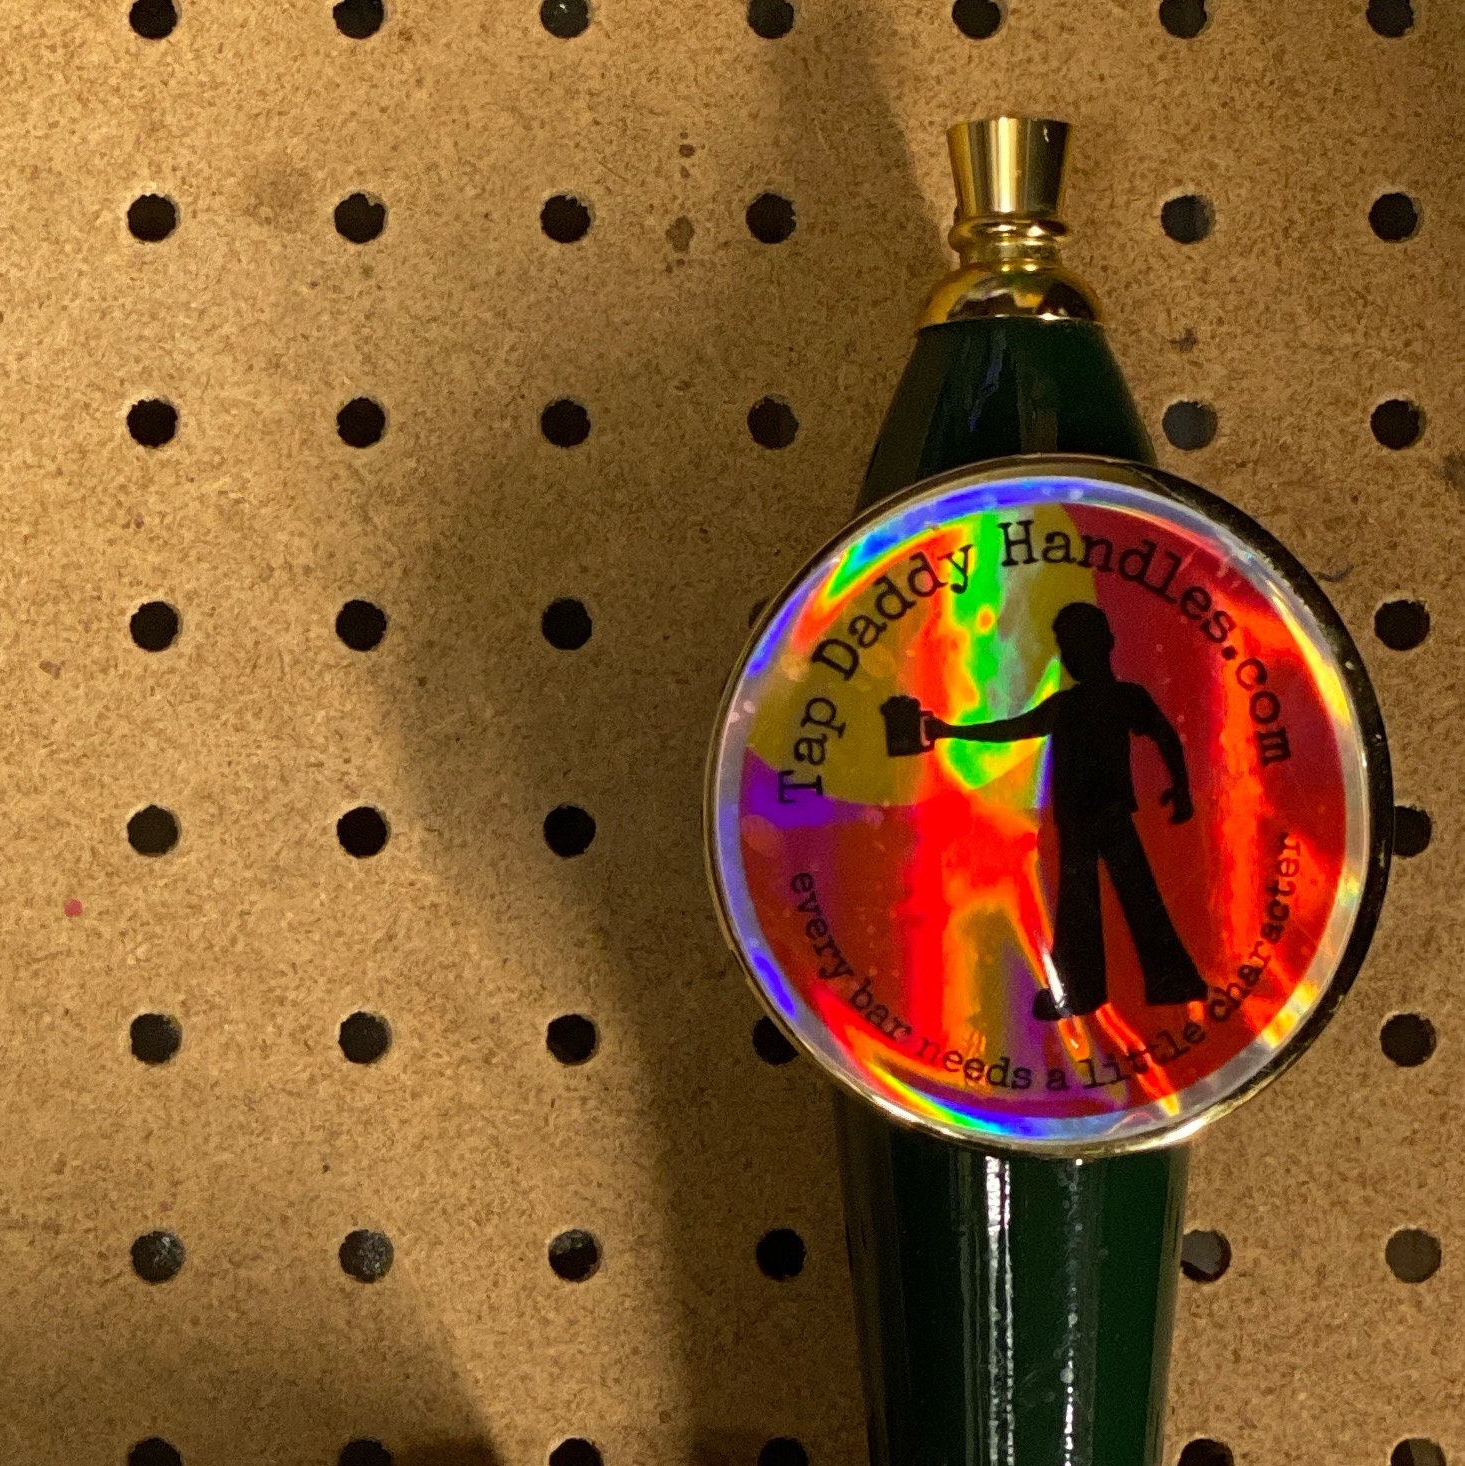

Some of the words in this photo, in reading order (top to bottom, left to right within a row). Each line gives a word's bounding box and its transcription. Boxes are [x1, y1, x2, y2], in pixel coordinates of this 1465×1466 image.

[811, 546, 976, 681] Daddy
[997, 518, 1294, 767] Handles.com
[777, 699, 847, 804] Tap
[791, 872, 855, 982] every
[853, 982, 913, 1042] bar
[915, 1033, 1033, 1092] needs
[1046, 1066, 1072, 1092] a
[1080, 1022, 1208, 1092] little
[1206, 830, 1303, 1030] character
